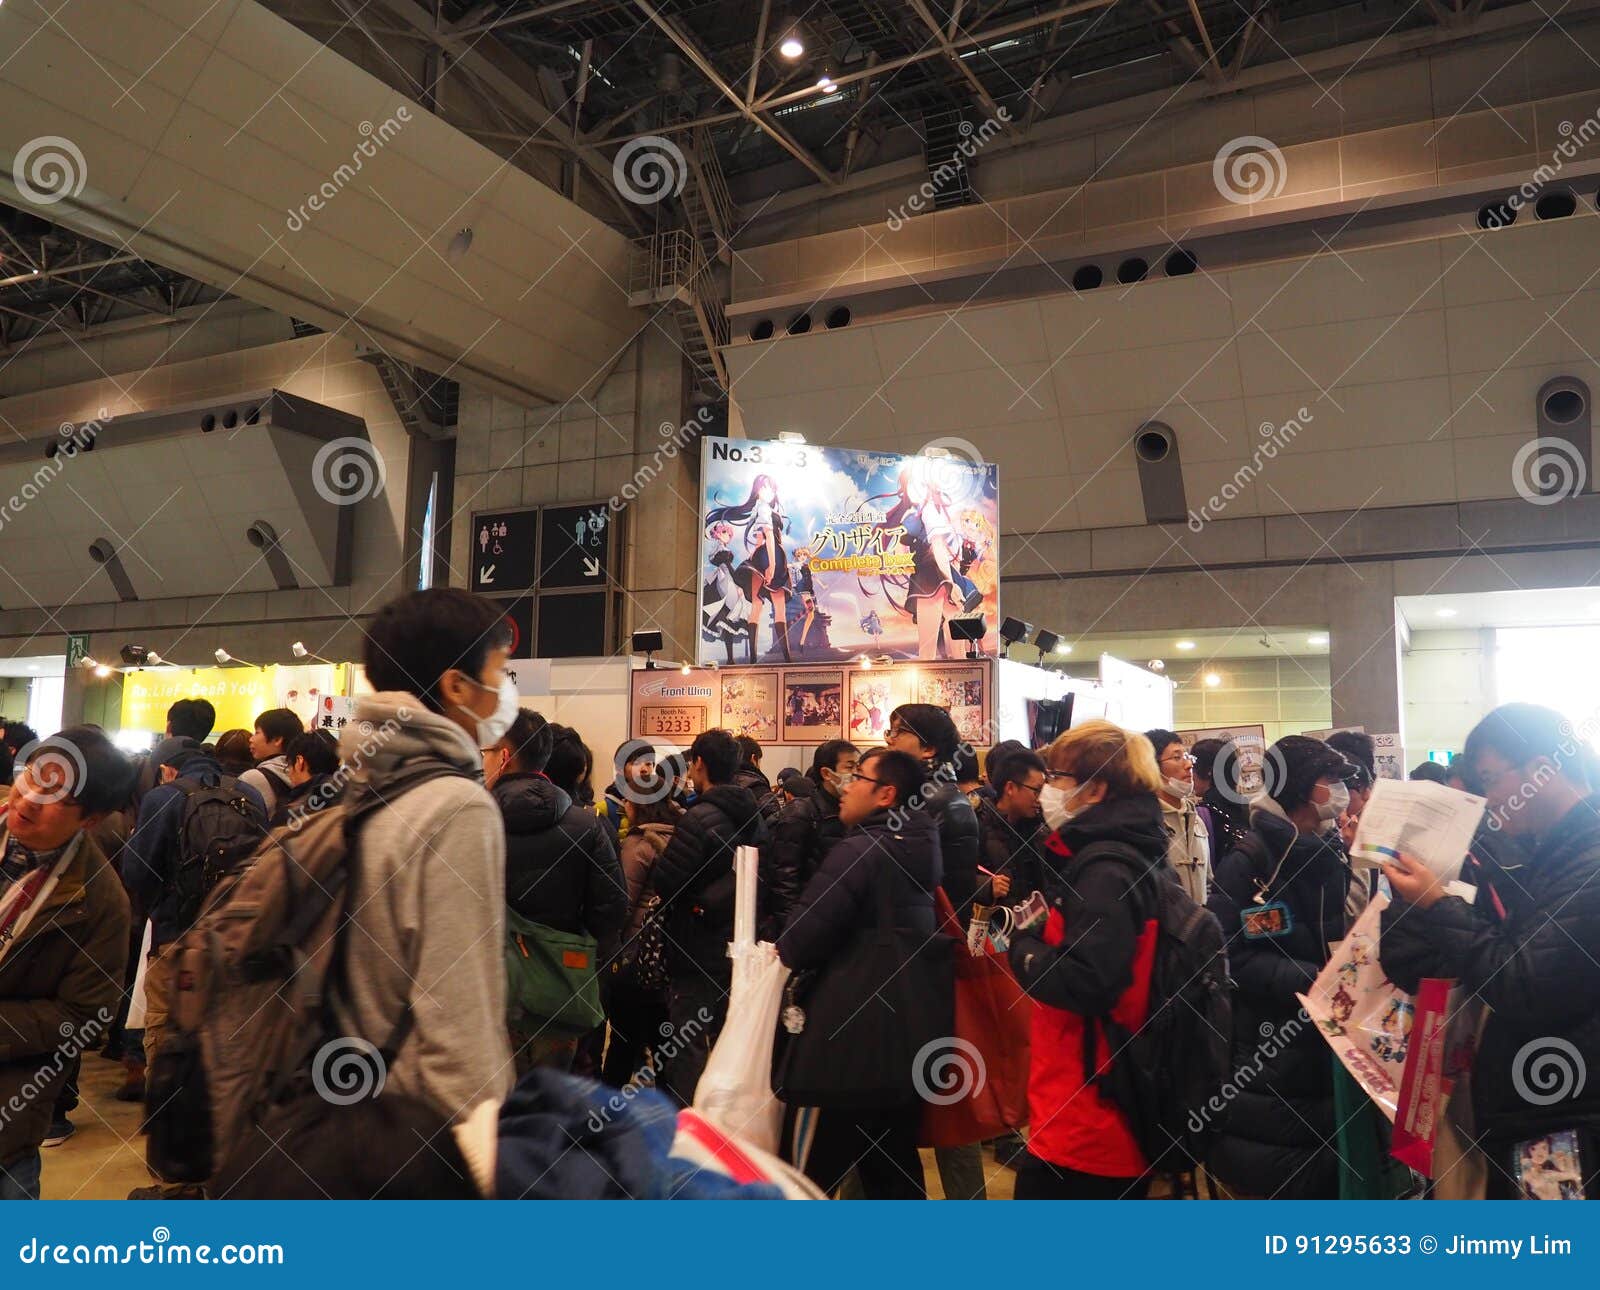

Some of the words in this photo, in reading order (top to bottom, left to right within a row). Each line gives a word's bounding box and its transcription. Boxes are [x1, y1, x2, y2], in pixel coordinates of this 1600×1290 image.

[711, 441, 807, 468] No.33
[809, 523, 907, 558] グリザイア
[808, 553, 882, 573] Complete
[661, 687, 686, 697] Front
[687, 686, 712, 698] Wing
[656, 720, 691, 732] 3233
